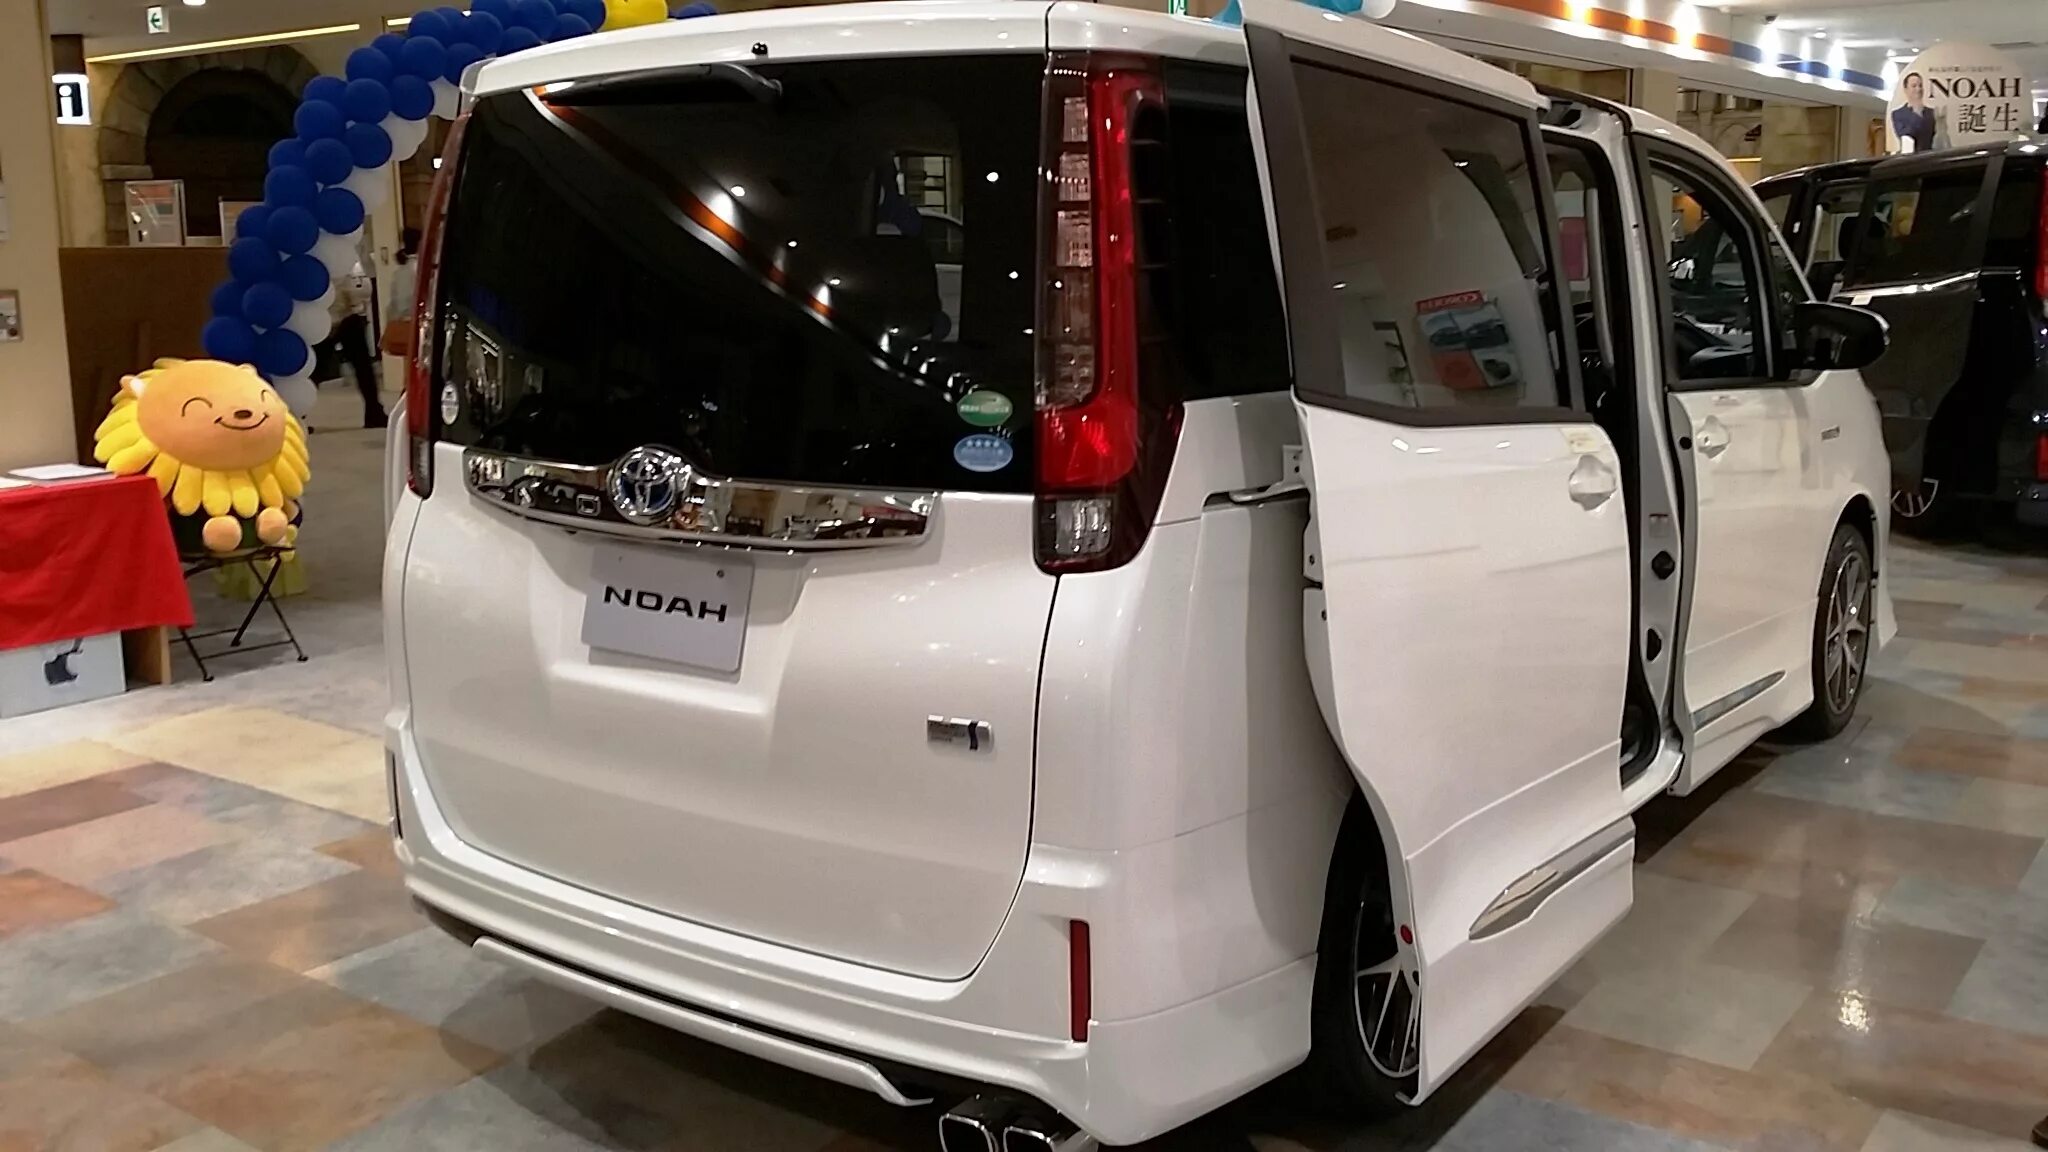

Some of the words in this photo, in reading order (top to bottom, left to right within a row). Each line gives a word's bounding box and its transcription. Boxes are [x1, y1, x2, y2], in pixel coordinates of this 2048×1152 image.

[1928, 77, 2022, 99] NOAH
[1957, 102, 2020, 134] 誕生
[603, 585, 728, 623] NOAH
